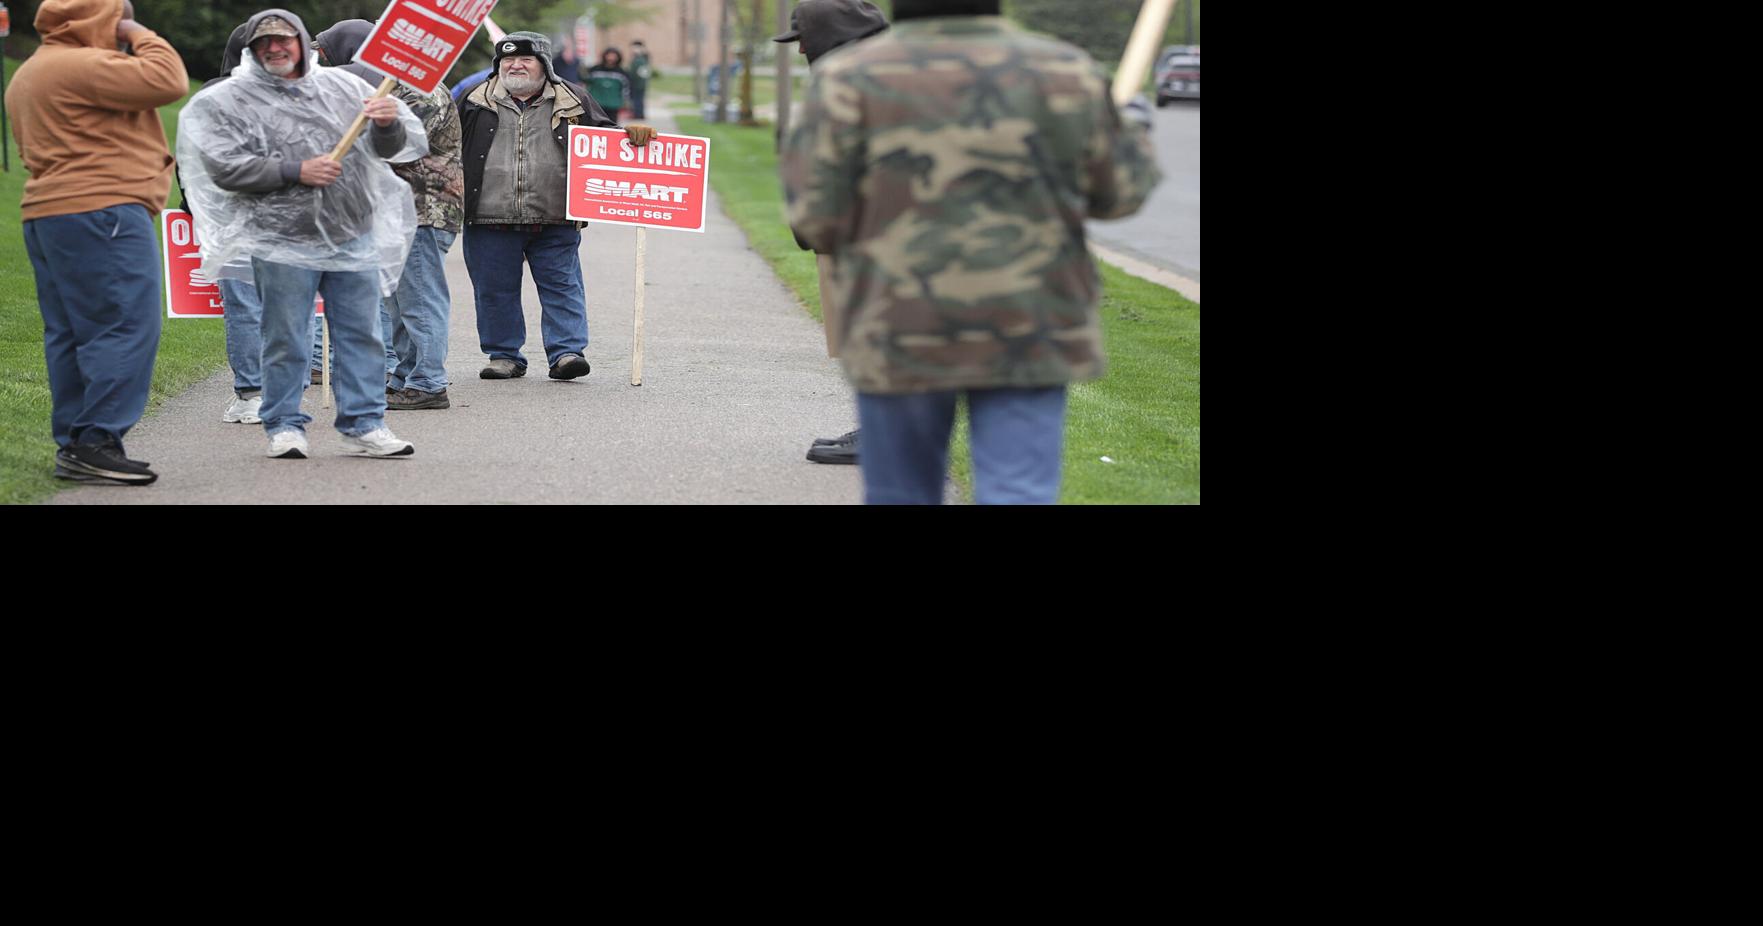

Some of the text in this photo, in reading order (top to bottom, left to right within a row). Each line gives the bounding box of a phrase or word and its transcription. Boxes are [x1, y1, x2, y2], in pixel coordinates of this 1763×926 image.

[387, 18, 455, 63] SMART
[381, 52, 411, 72] Local
[574, 133, 608, 160] ON
[584, 178, 689, 203] SMART
[599, 206, 673, 220] Local 565
